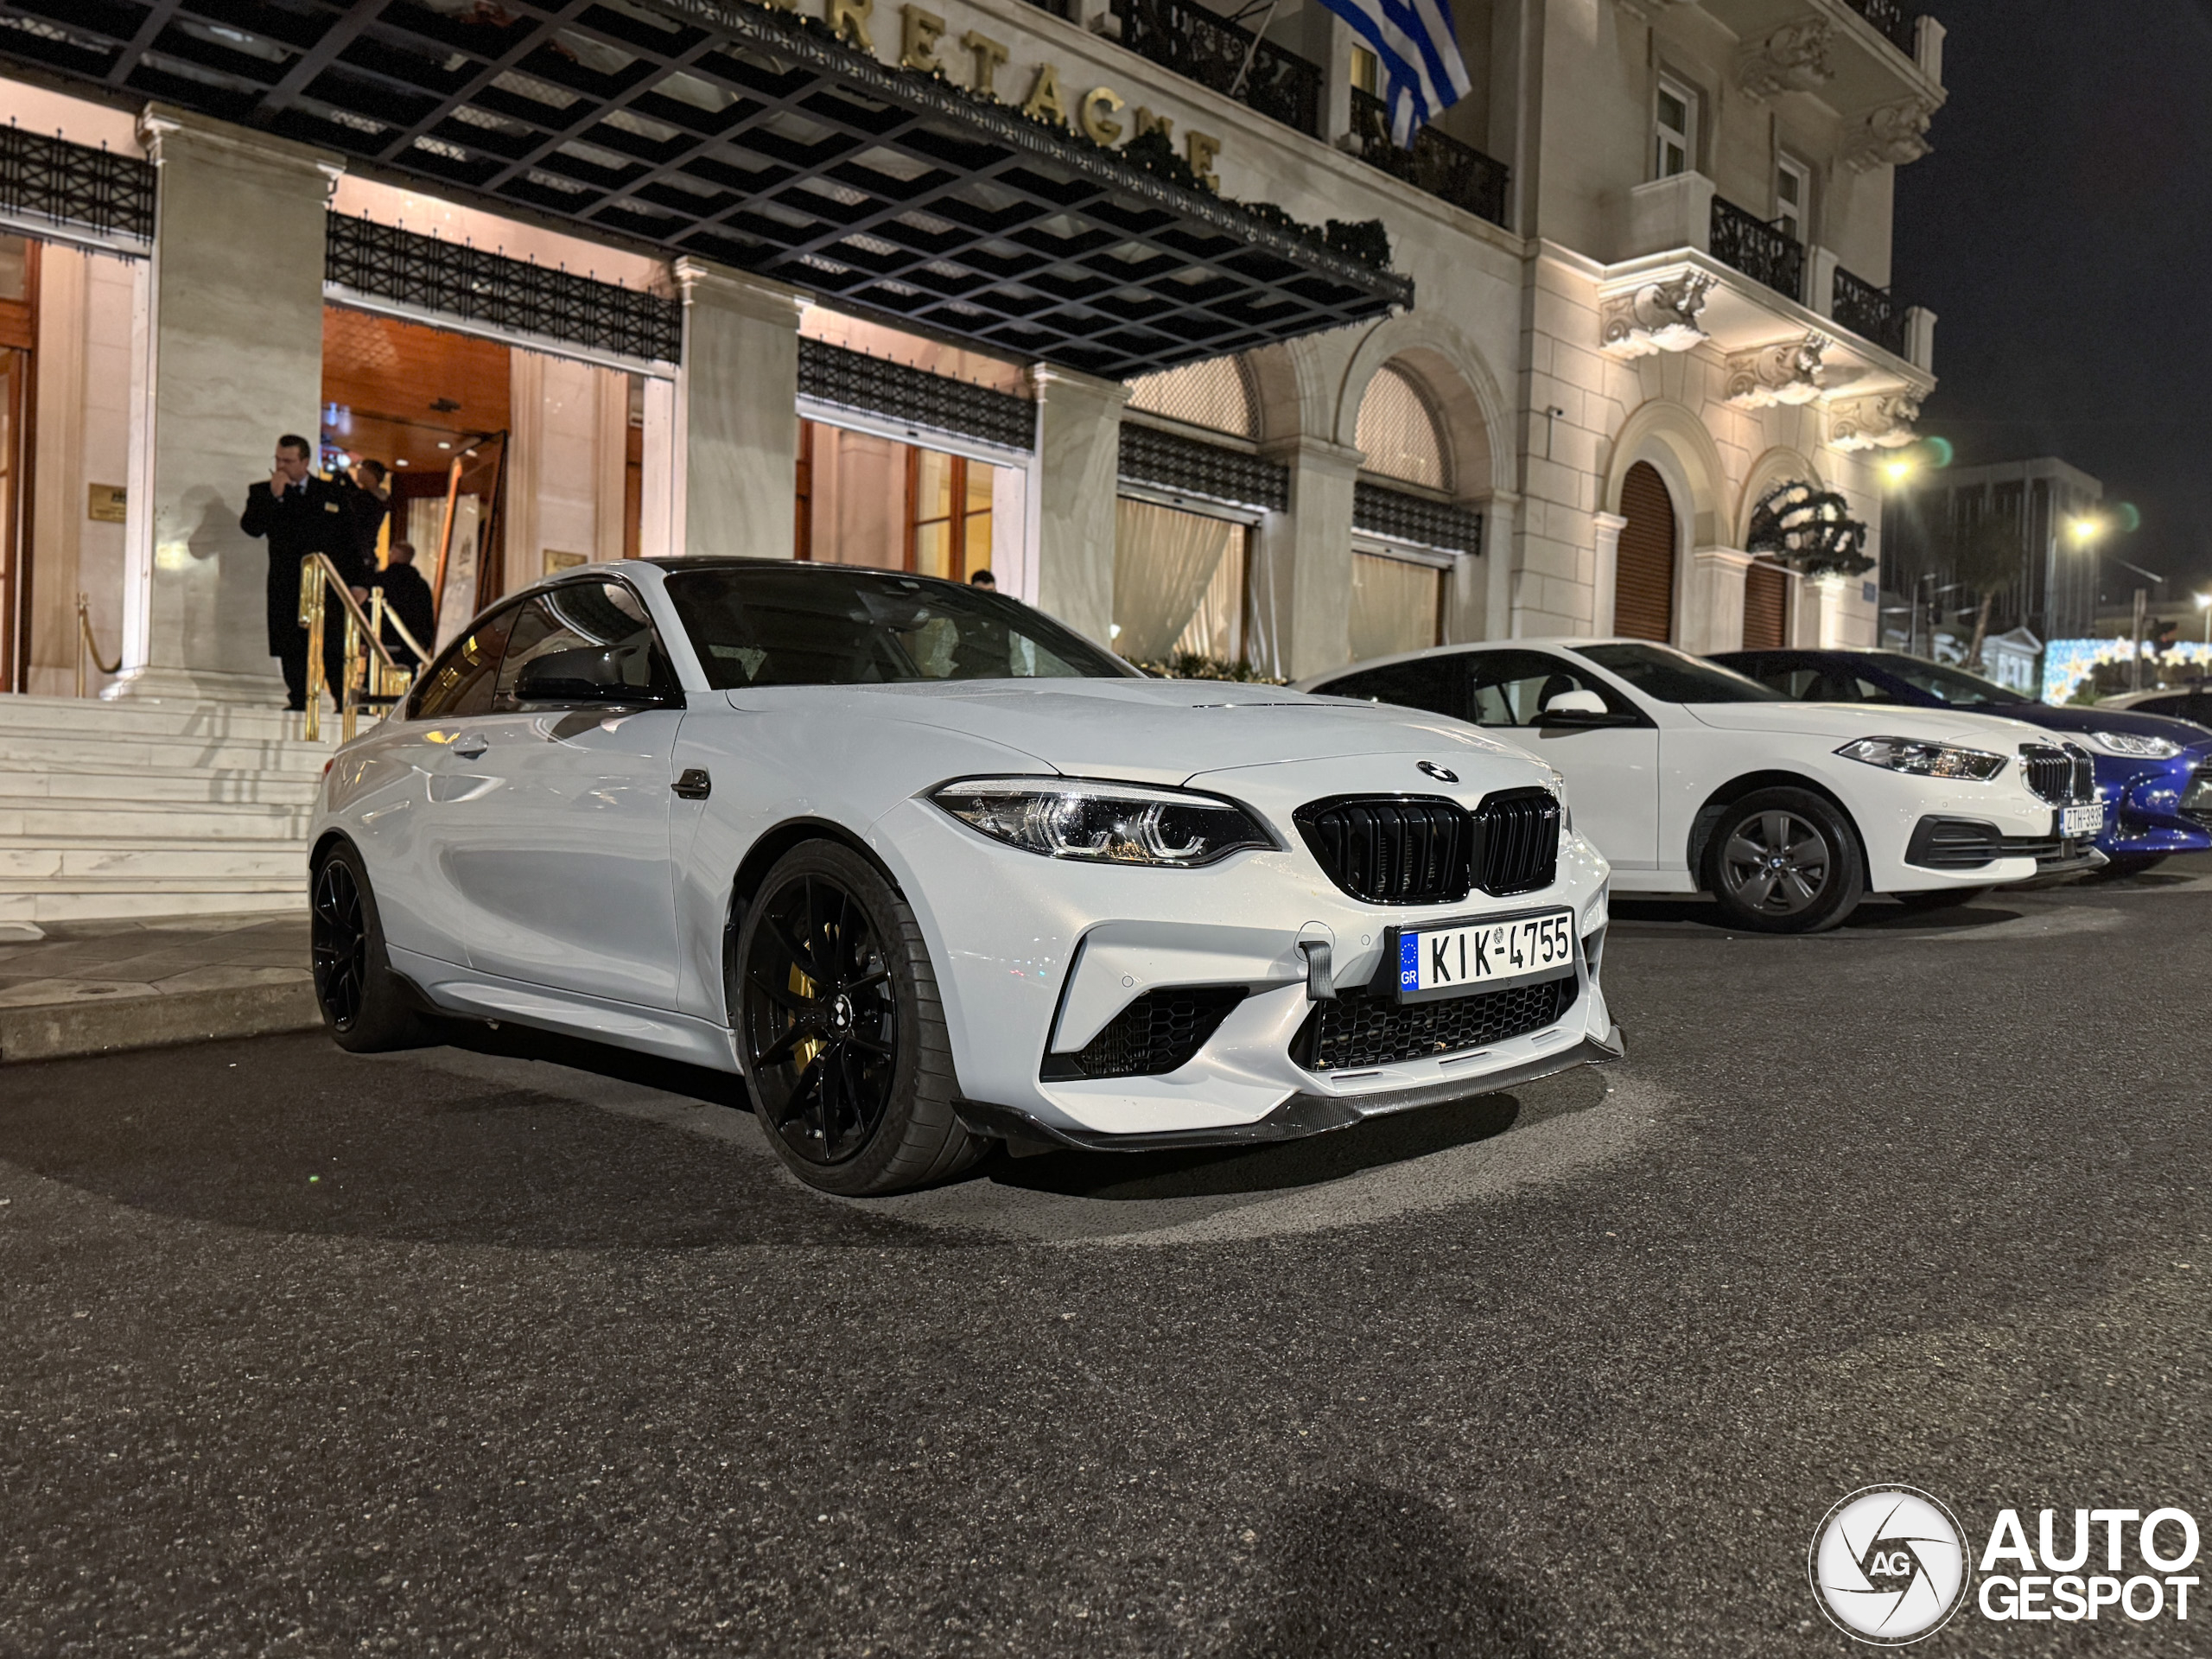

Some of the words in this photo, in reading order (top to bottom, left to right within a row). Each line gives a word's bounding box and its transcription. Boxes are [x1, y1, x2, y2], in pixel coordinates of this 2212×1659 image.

[2067, 806, 2101, 830] ZTH-3935
[1431, 916, 1568, 984] KIK-4755
[1400, 969, 1417, 985] GR
